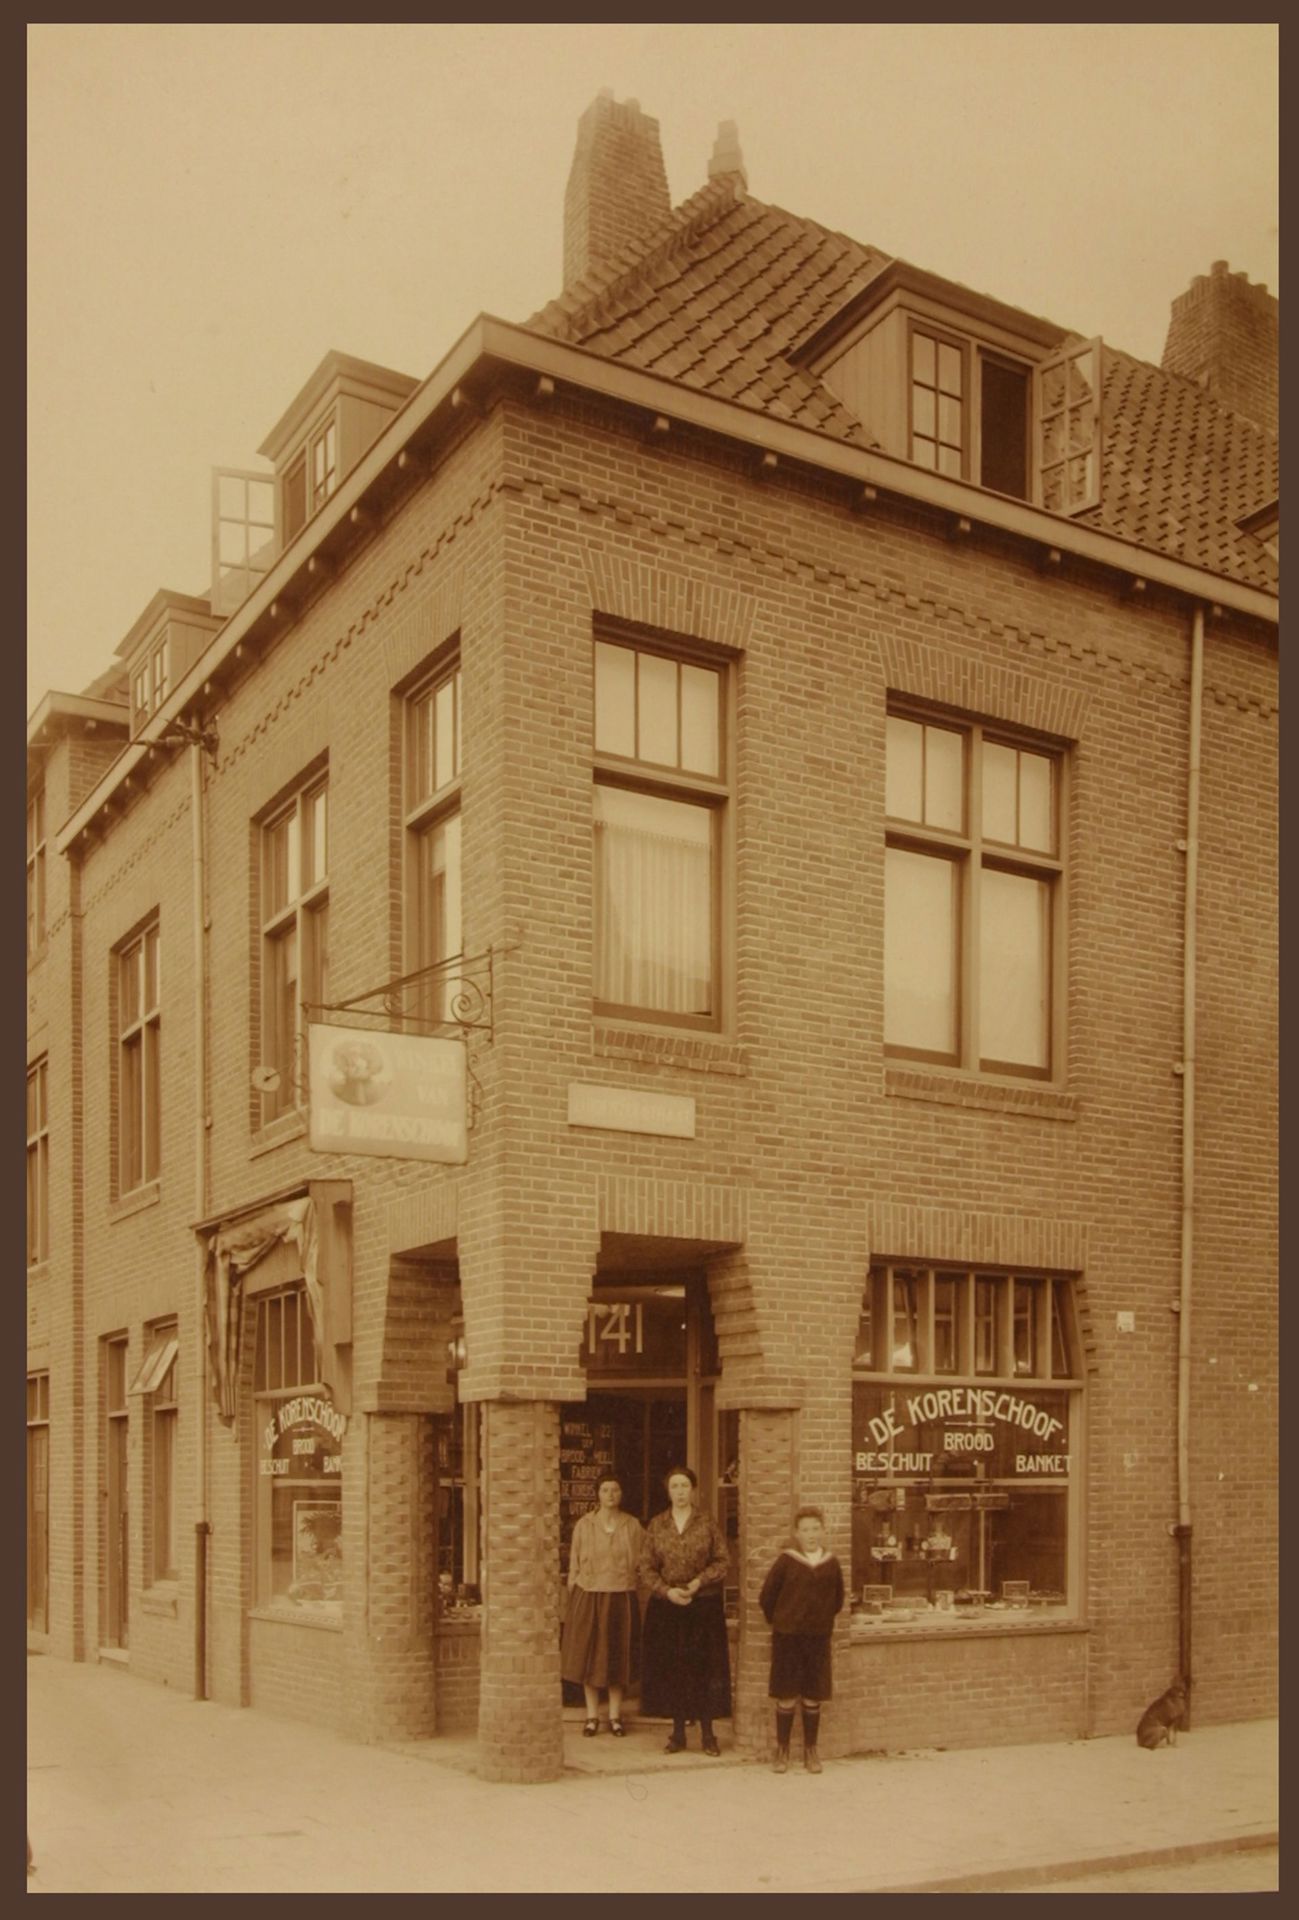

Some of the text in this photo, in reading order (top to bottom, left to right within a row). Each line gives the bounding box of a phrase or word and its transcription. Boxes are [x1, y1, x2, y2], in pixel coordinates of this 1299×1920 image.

[589, 1303, 643, 1354] 141
[868, 1388, 1063, 1446] DE KORENSCHOOF
[264, 1418, 280, 1451] DE
[292, 1438, 315, 1456] BROOD
[944, 1432, 995, 1451] BROOD
[856, 1452, 1073, 1473] BESCHUIT BANKET
